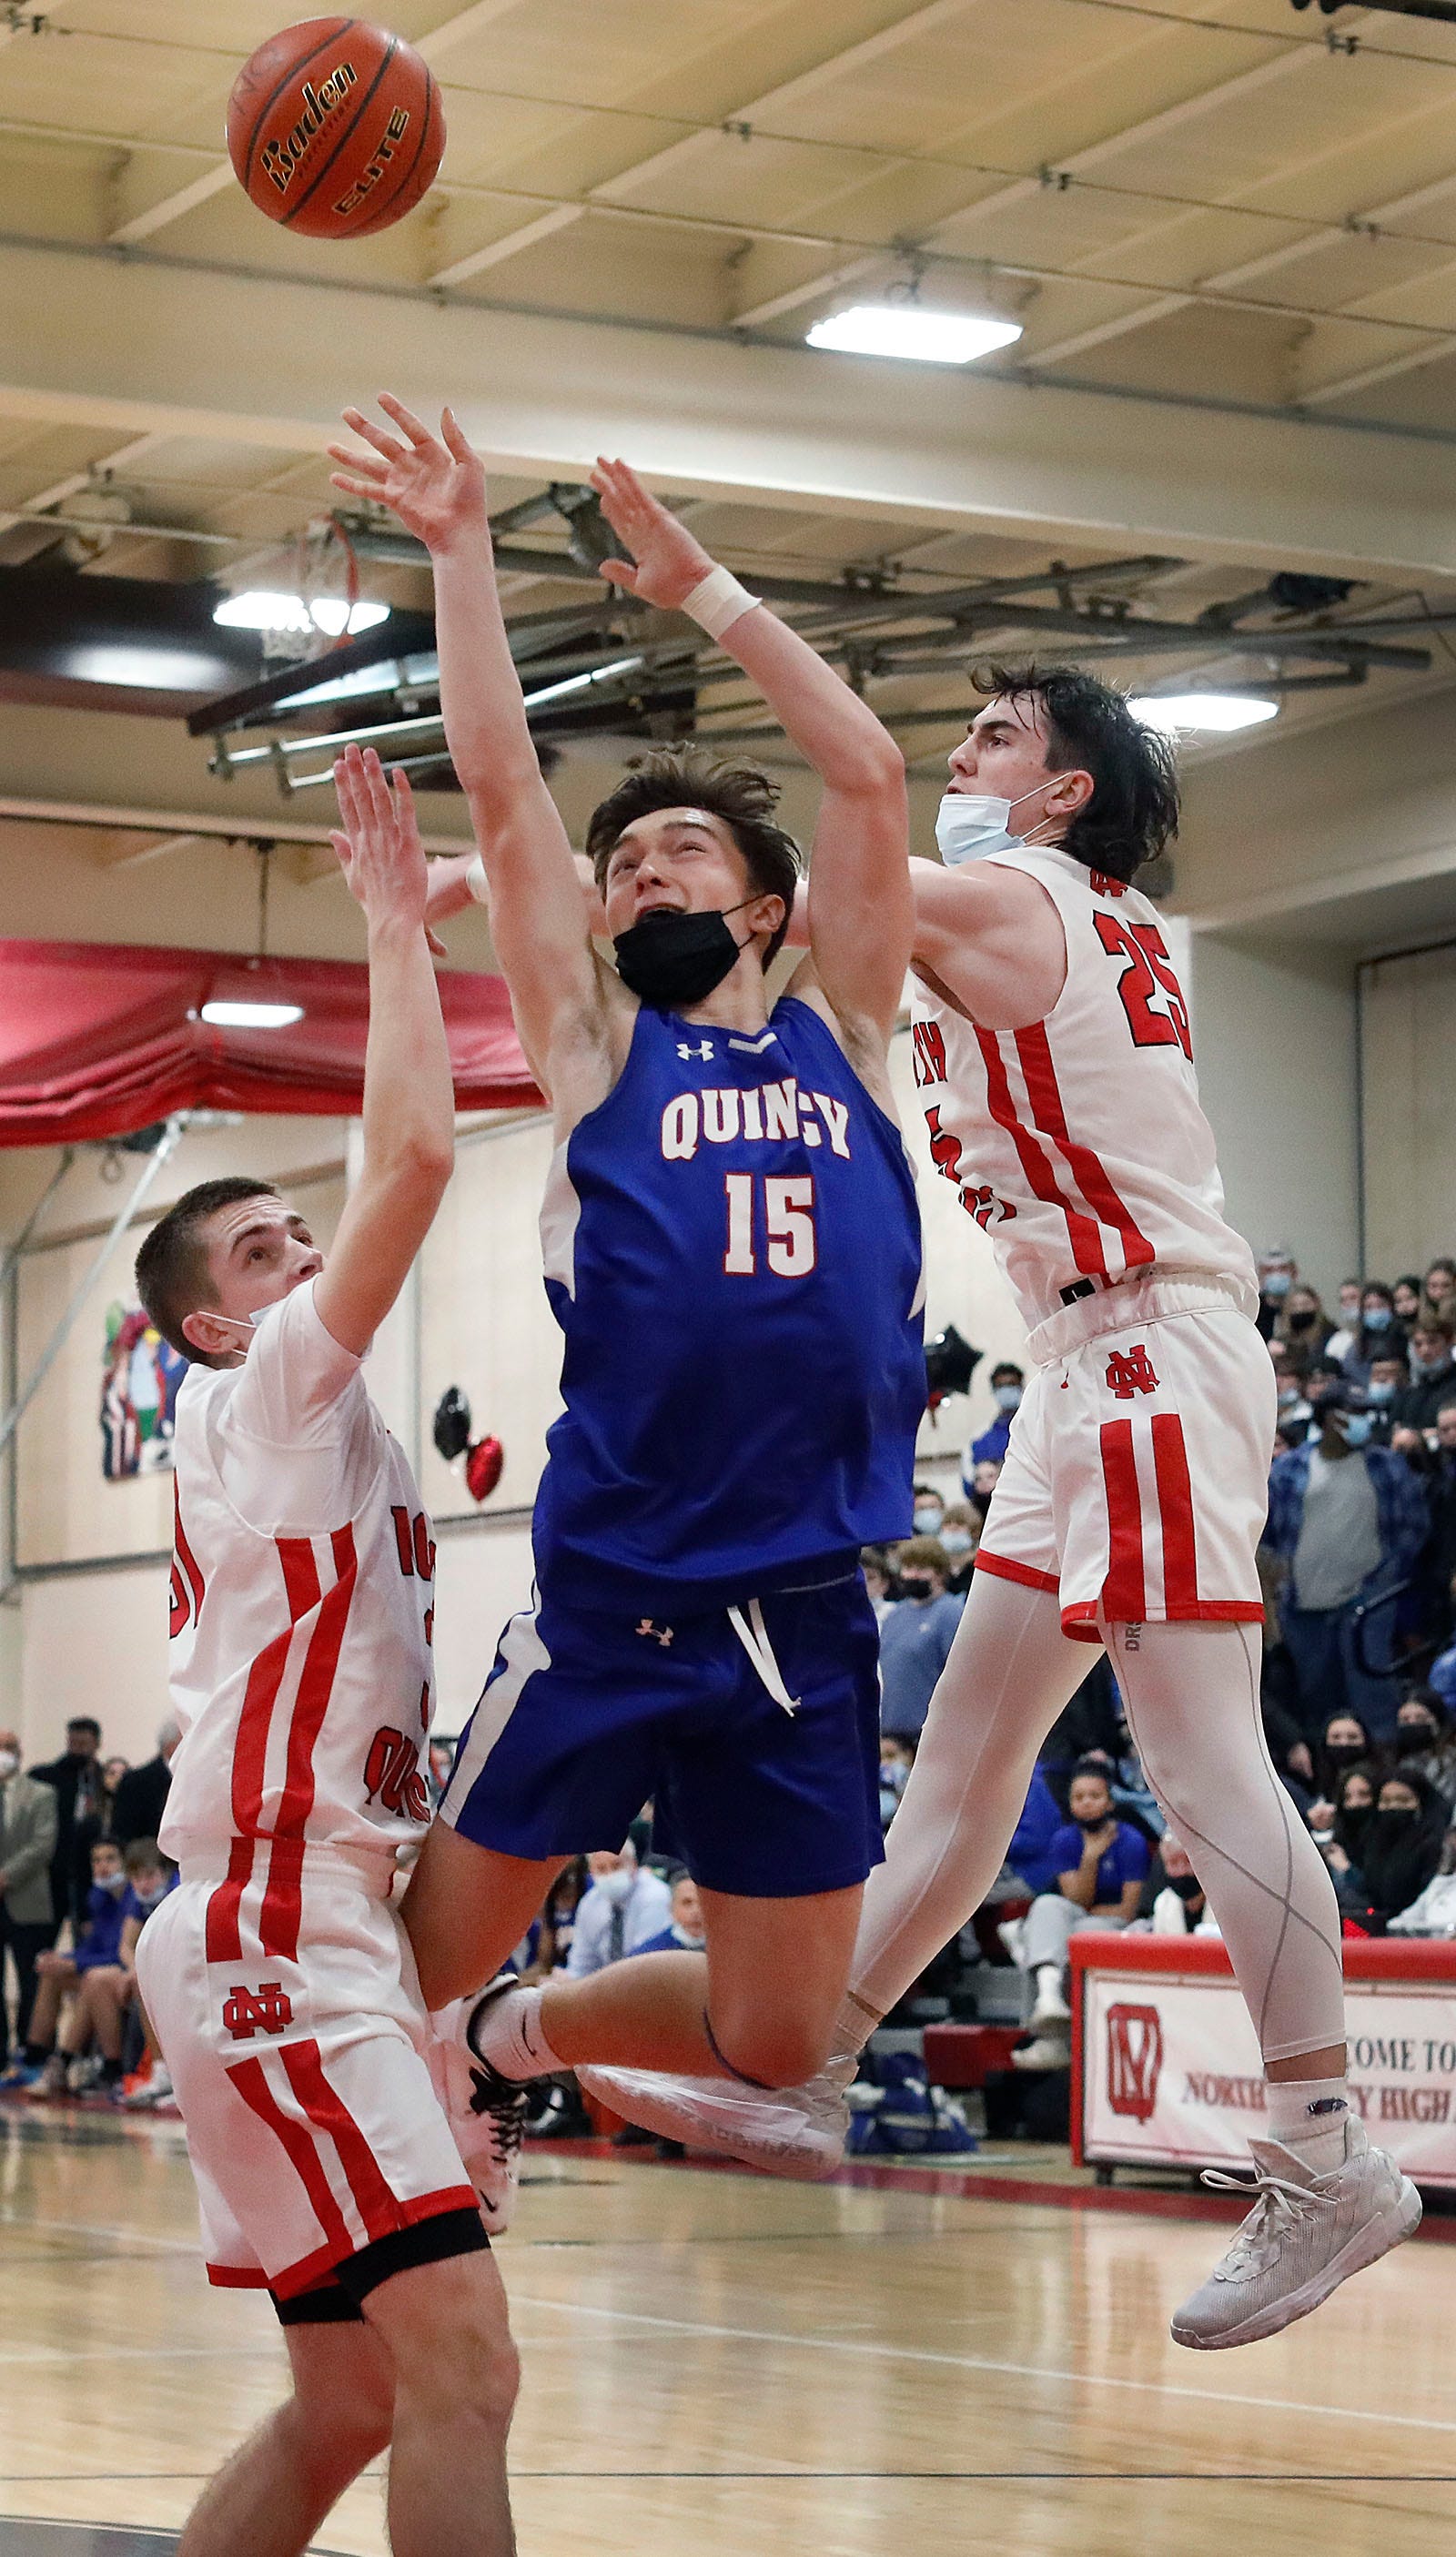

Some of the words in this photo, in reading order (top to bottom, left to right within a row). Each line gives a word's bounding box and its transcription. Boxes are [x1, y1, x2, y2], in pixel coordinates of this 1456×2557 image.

[260, 63, 358, 194] Baden
[331, 106, 410, 216] ELITE
[1092, 910, 1194, 1064] 25
[661, 1077, 851, 1160] QUINCY
[723, 1171, 817, 1278] 15
[1125, 1621, 1142, 1652] DR
[1182, 2071, 1268, 2111] NORTH
[1380, 2087, 1451, 2122] HIGH
[1422, 2040, 1456, 2072] TO
